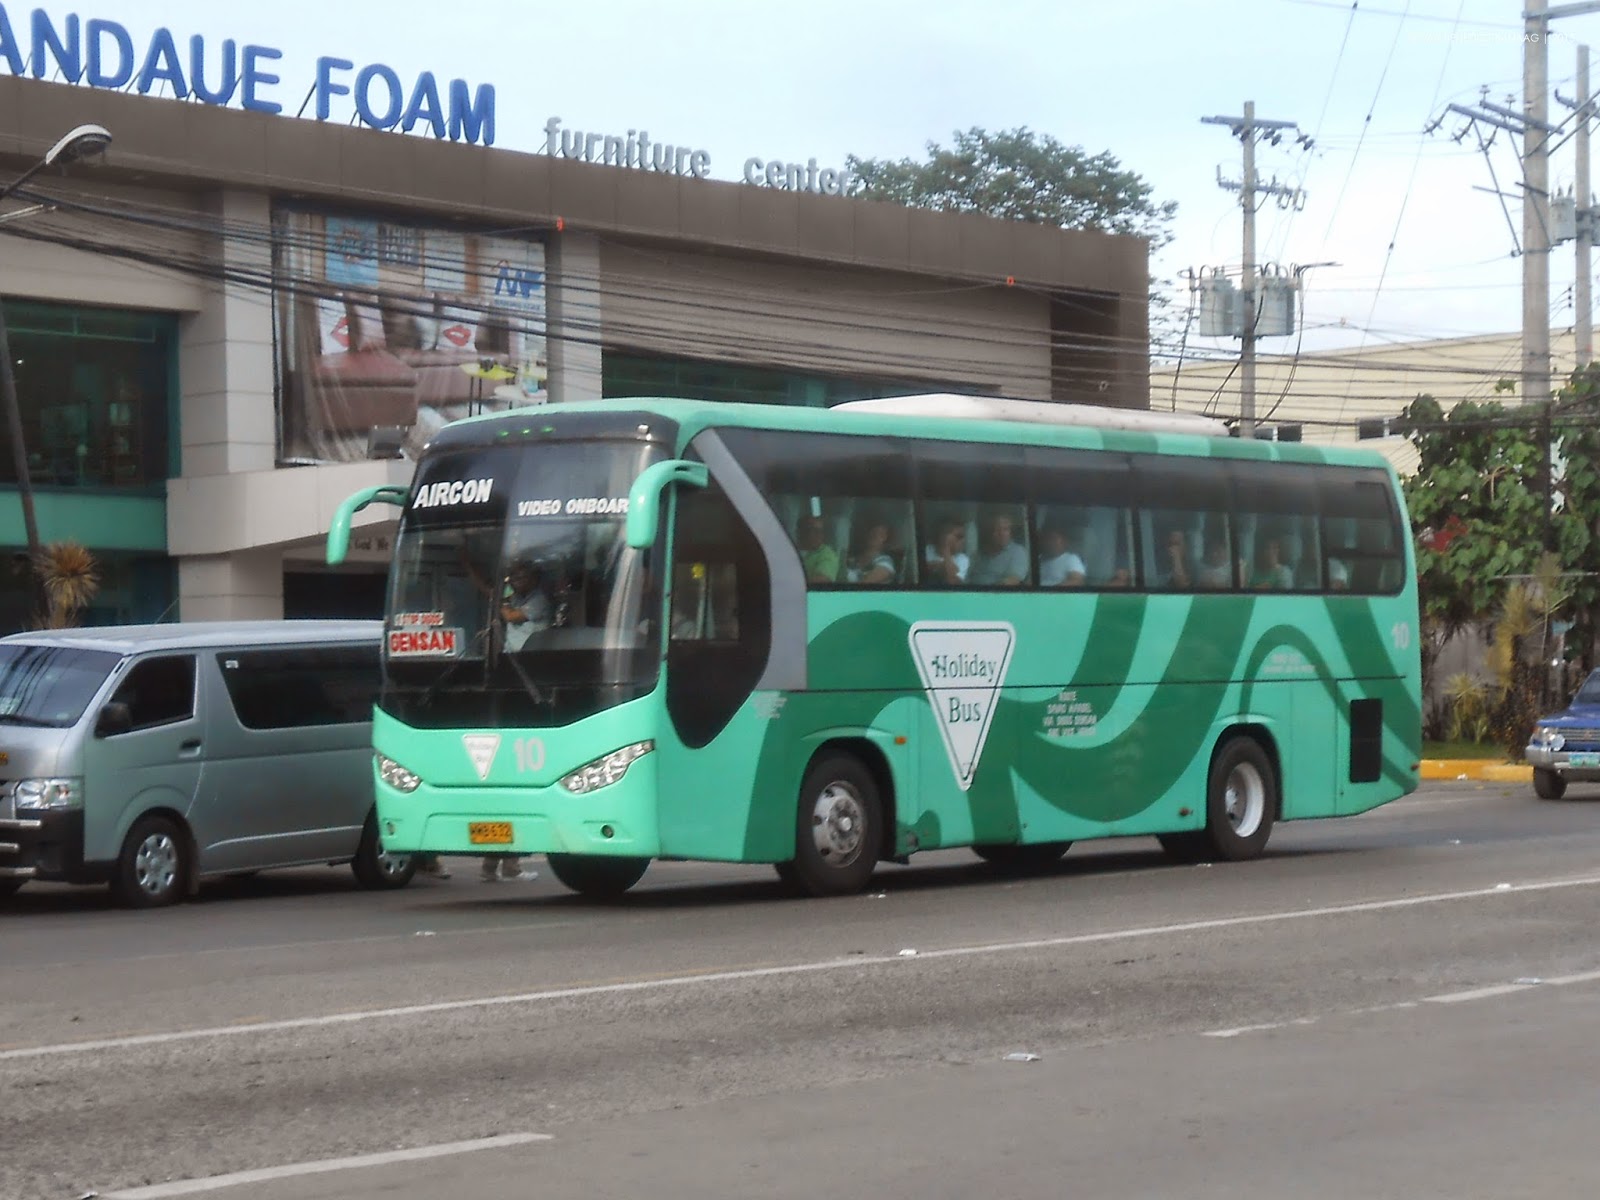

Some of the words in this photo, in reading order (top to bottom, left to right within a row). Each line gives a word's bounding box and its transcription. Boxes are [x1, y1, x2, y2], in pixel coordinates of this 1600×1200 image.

[315, 55, 496, 147] FOAM
[544, 116, 712, 179] furniture
[743, 156, 855, 197] center
[413, 478, 494, 509] AIRCON
[518, 499, 561, 517] VIDEO
[564, 497, 629, 514] ONBOAR
[390, 630, 455, 652] GENSAN
[1391, 622, 1410, 650] 10
[931, 653, 998, 683] Holiday
[948, 696, 982, 724] Bus
[513, 737, 545, 773] 10
